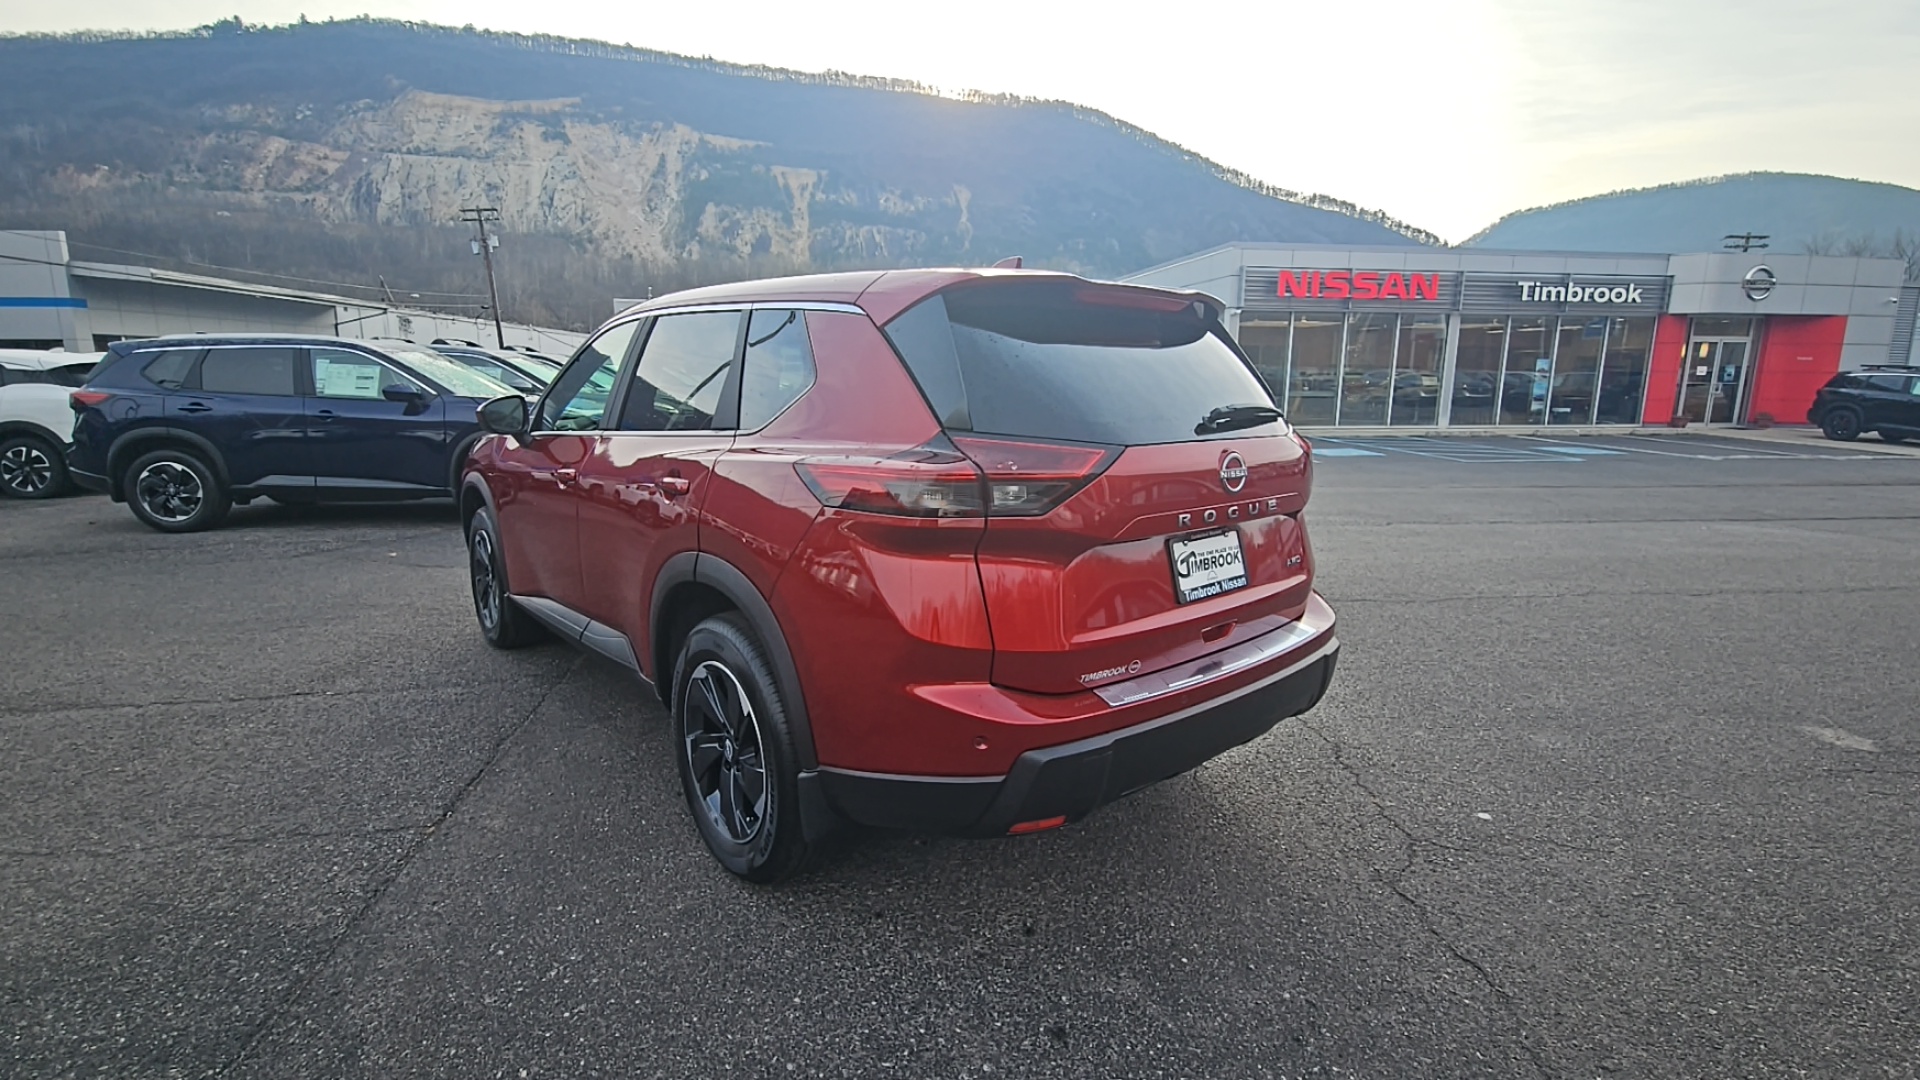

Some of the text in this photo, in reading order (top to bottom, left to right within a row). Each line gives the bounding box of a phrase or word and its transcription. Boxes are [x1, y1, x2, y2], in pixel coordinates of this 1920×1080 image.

[1277, 270, 1439, 301] NISSAN
[1517, 281, 1643, 303] Timbrook
[1178, 498, 1279, 527] ROGUE
[1177, 550, 1241, 578] TIMBROOK
[1184, 577, 1247, 602] Timbrook Nissan
[1080, 664, 1128, 683] TIMBROOK
